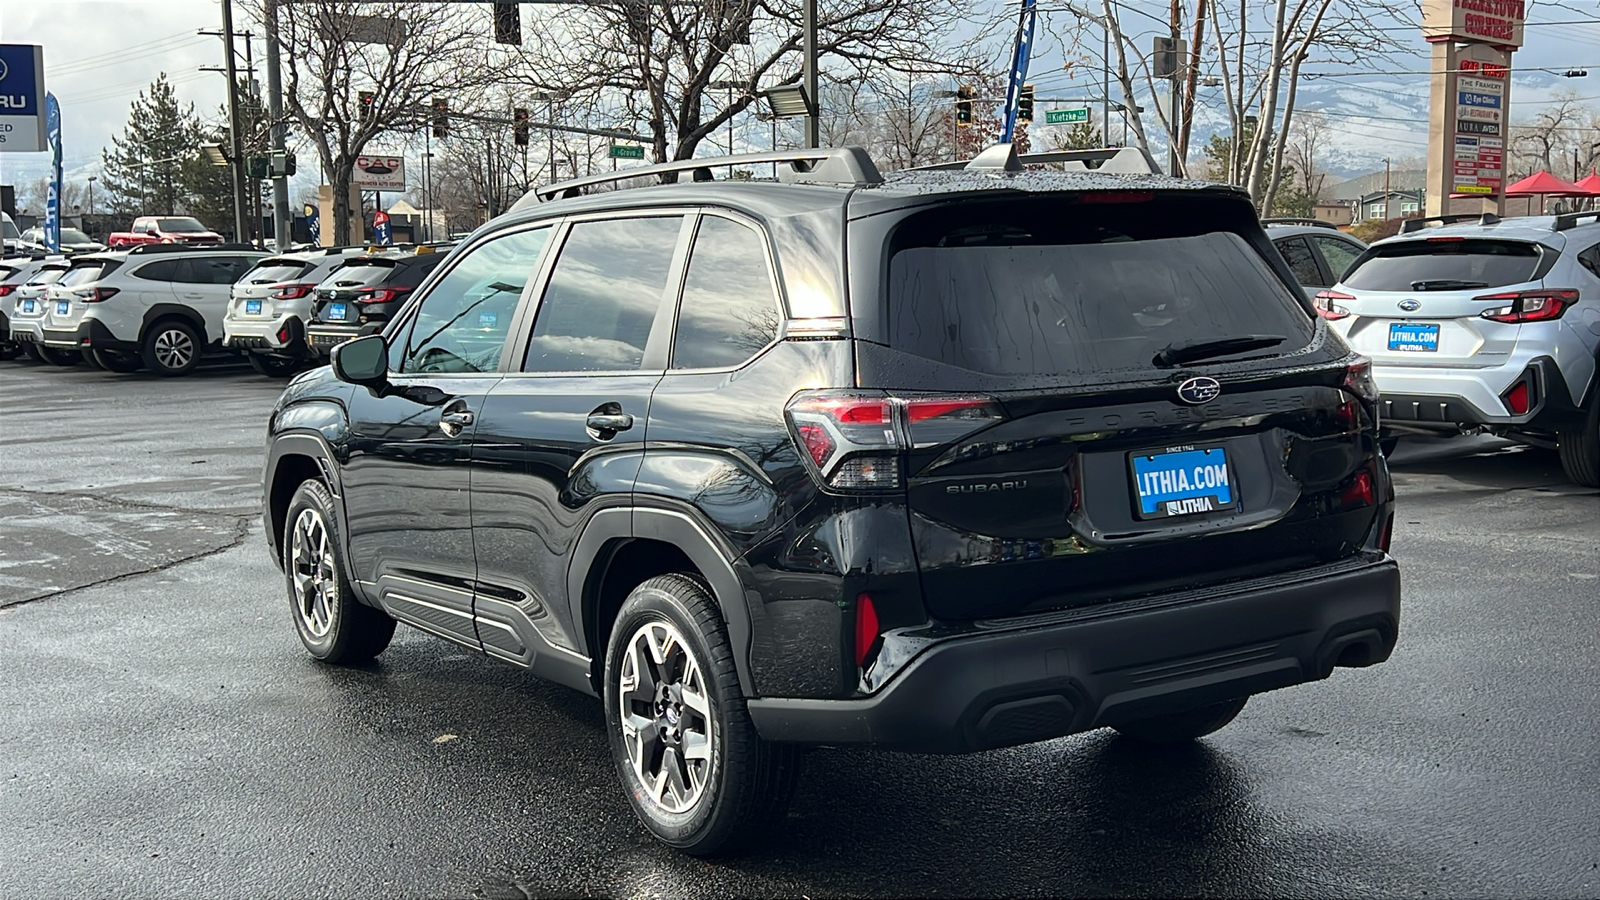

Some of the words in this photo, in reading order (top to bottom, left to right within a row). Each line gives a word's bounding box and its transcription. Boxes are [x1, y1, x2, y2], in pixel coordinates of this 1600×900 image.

[1465, 13, 1514, 40] CORNERS
[1475, 81, 1502, 90] FRAMERY
[1473, 95, 1482, 104] Eye
[1482, 96, 1495, 104] Clinic
[1052, 112, 1076, 122] Kietzke
[1459, 122, 1479, 132] AURA
[1390, 331, 1437, 343] LITHIA.COM
[1166, 446, 1182, 454] SINCE
[1136, 463, 1229, 497] LITHIA.COM
[946, 480, 1027, 494] SUBARU
[1177, 497, 1213, 515] LITHIA
